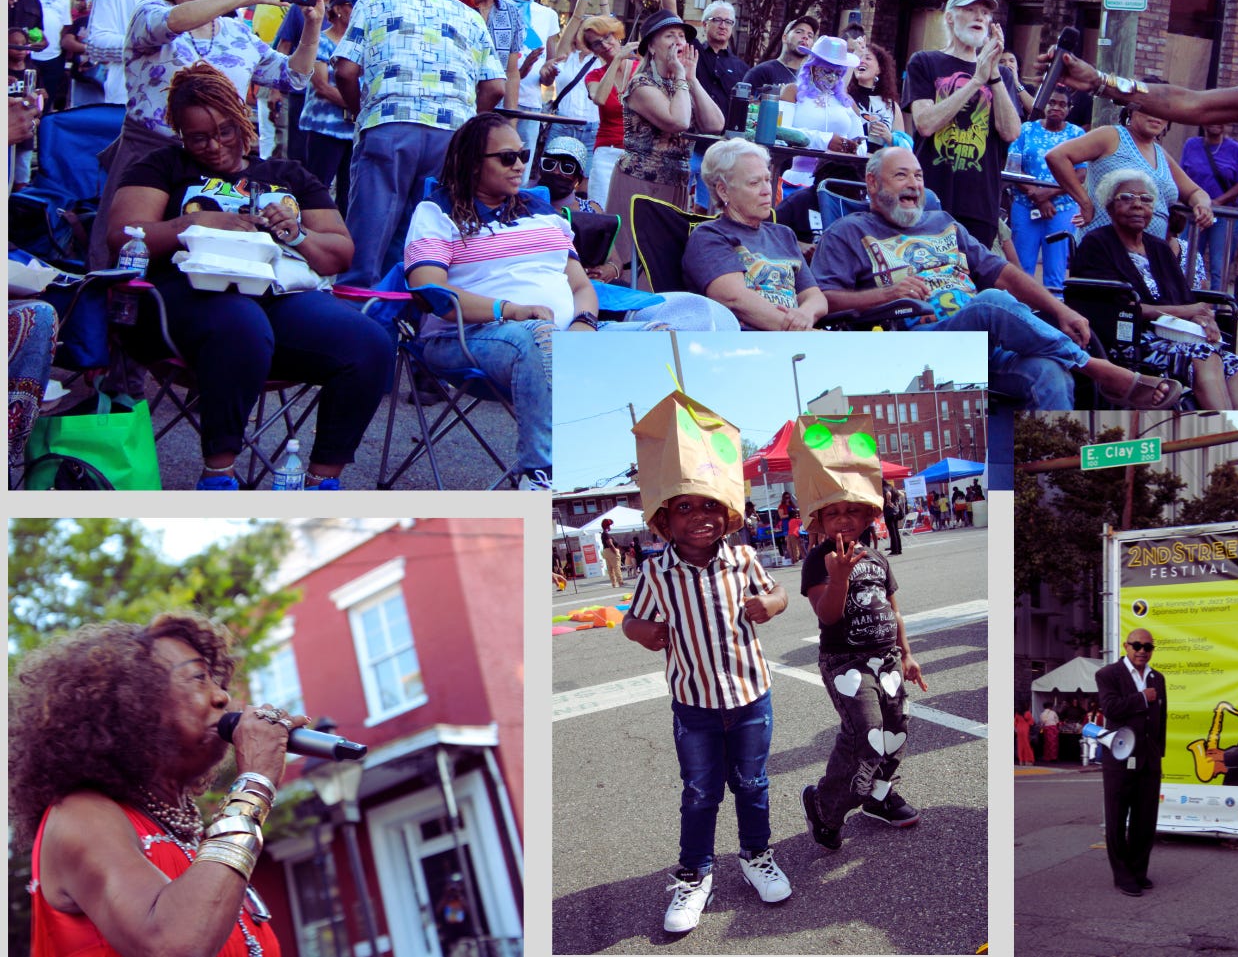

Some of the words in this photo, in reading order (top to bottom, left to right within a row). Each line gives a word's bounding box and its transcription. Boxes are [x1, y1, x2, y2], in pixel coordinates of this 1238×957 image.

[1087, 448, 1099, 461] E.
[1105, 446, 1134, 459] Clay
[1140, 441, 1155, 454] St
[1150, 562, 1229, 579] FESTIVAL
[1152, 607, 1189, 615] Sponsored
[1201, 605, 1231, 613] Walmart
